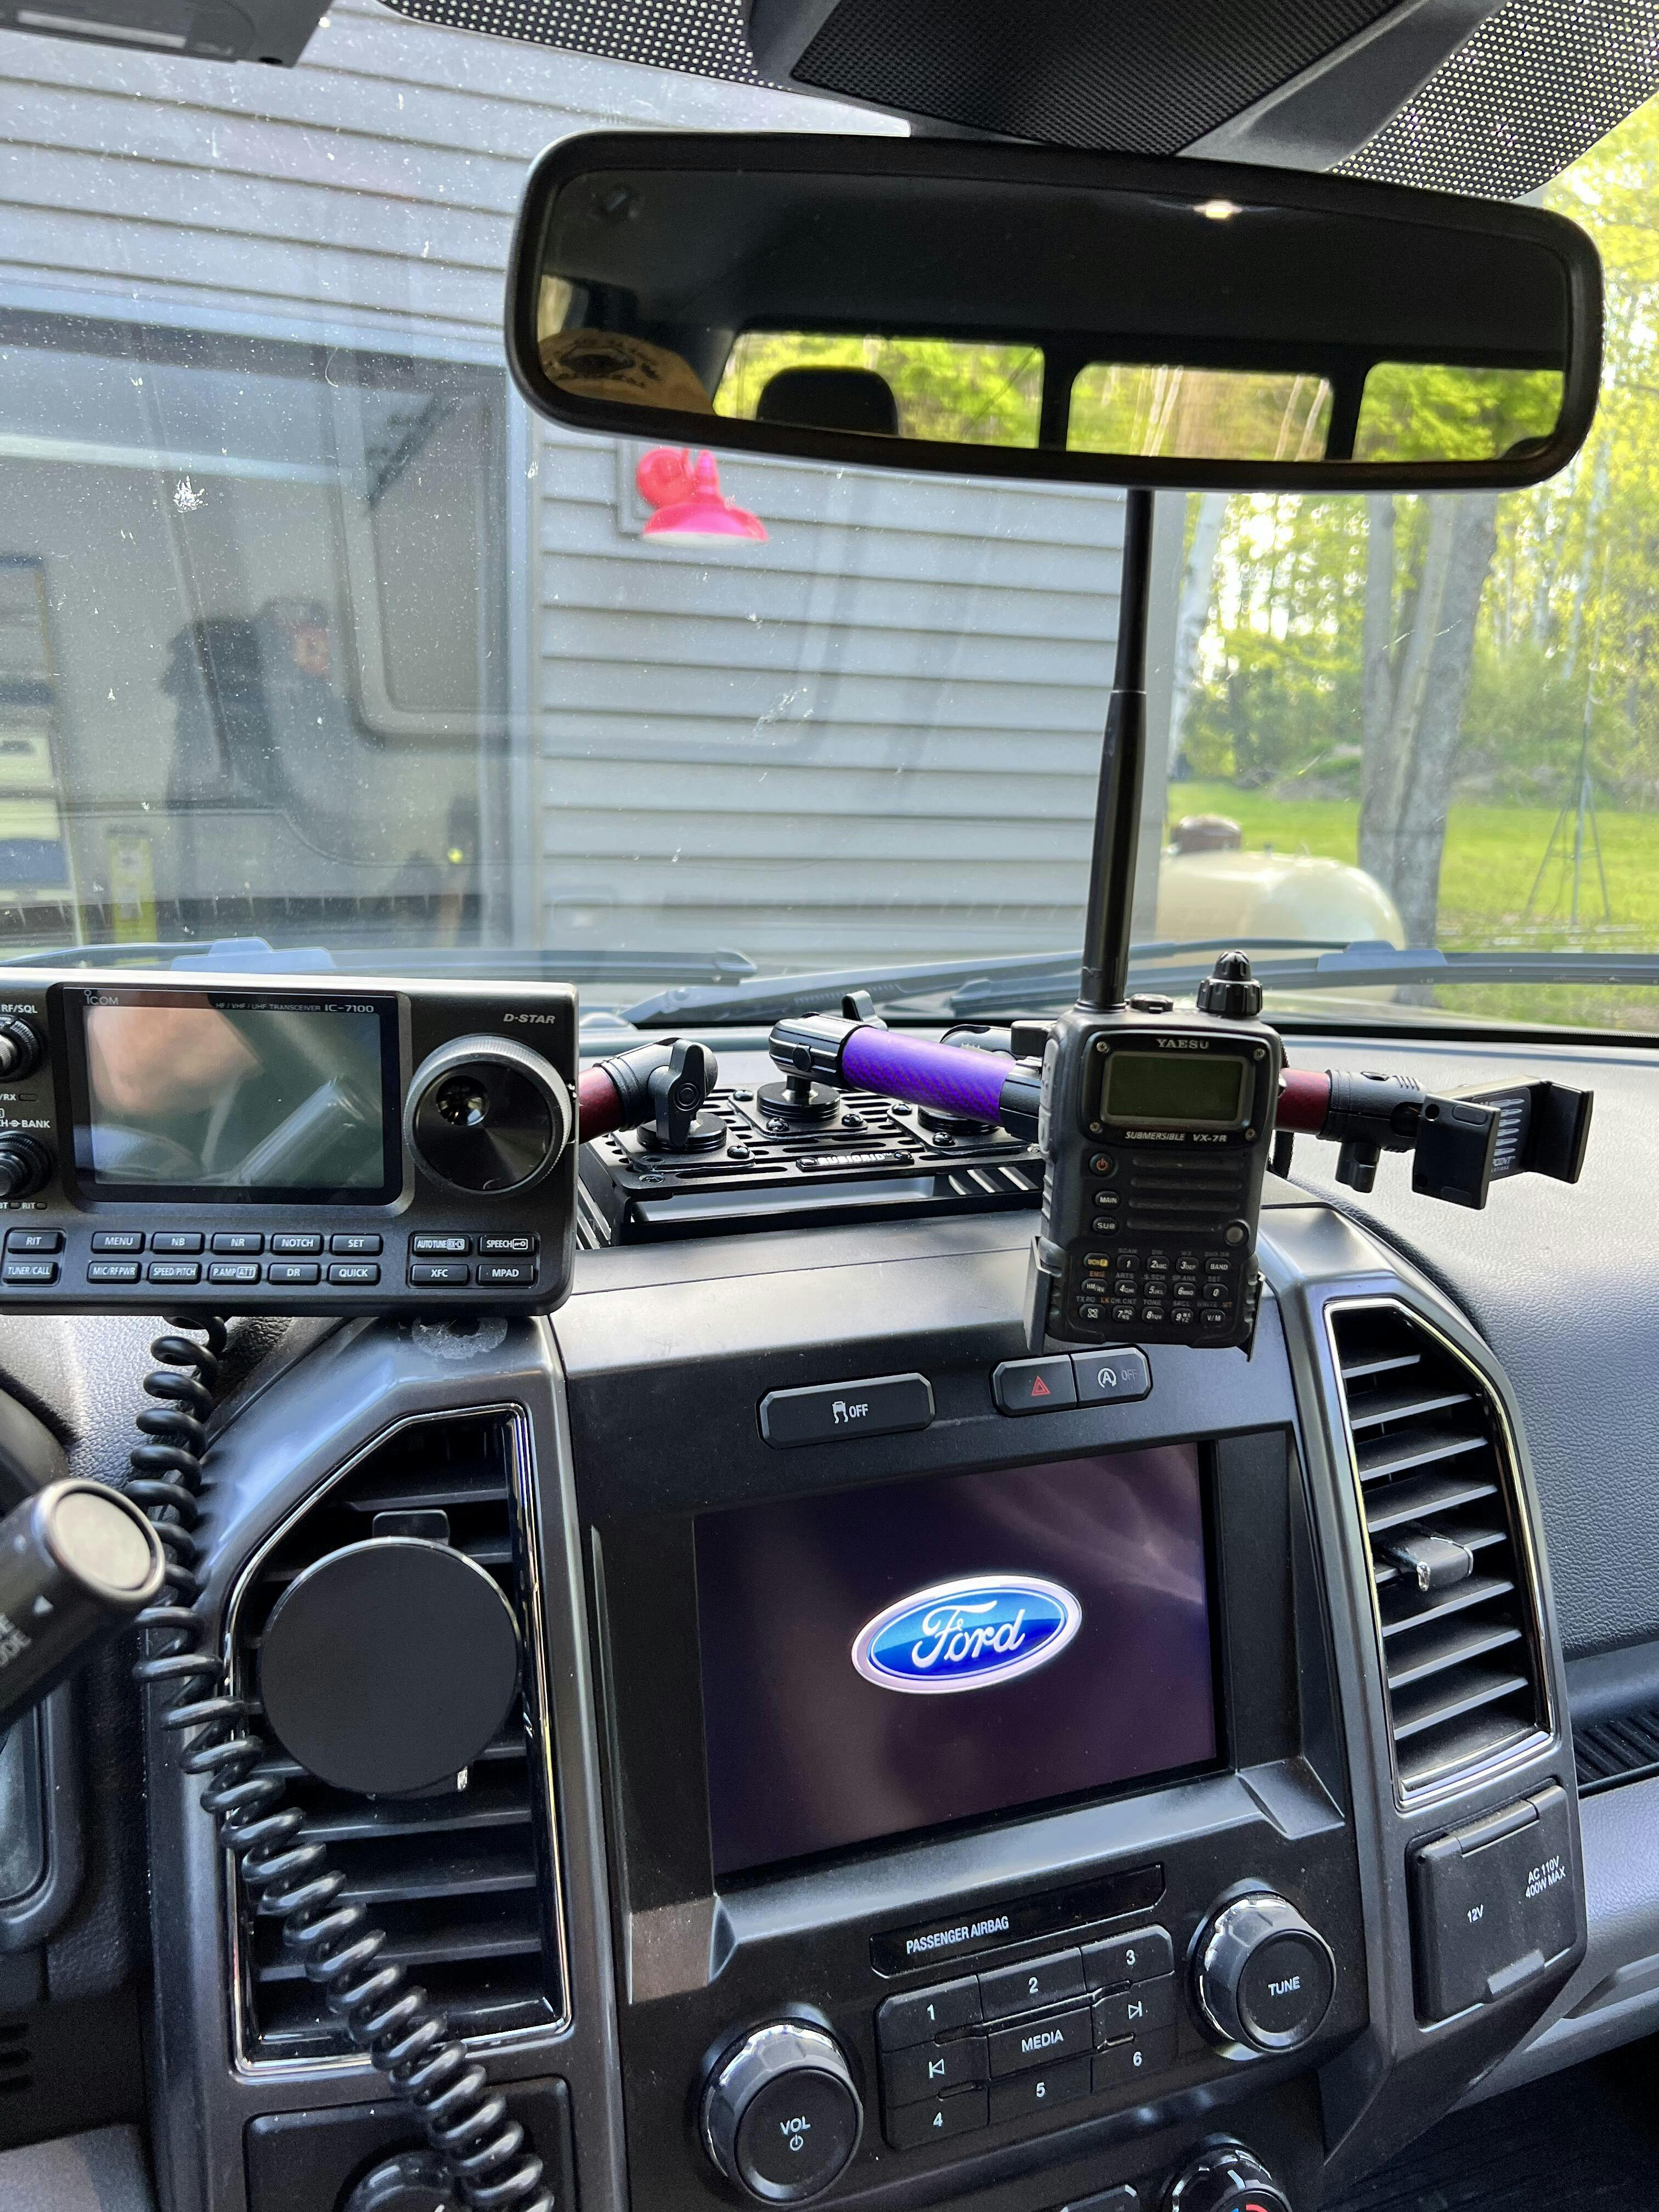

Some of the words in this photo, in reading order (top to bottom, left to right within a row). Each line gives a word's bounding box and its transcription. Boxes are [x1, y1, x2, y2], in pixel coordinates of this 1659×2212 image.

[1, 1004, 38, 1014] RF/SQL
[324, 1004, 374, 1013] IC-7100
[503, 1013, 556, 1024] D-STAR
[1156, 1039, 1210, 1049] YAESU
[21, 1119, 51, 1128] BANK
[1125, 1131, 1185, 1141] SUBMERSIBLE
[1193, 1134, 1227, 1142] VX-7R
[26, 1237, 42, 1245] RIT
[104, 1237, 133, 1245] MENU
[171, 1238, 185, 1246] NB
[230, 1238, 246, 1246] NR
[281, 1238, 314, 1247] NOTCH
[347, 1239, 365, 1248] SET
[486, 1239, 512, 1248] SPEECH
[286, 1268, 301, 1277] DR
[338, 1268, 369, 1278] QUICK
[431, 1269, 449, 1277] XFC
[492, 1269, 520, 1277] MPAD
[1212, 1288, 1220, 1297] 0
[1121, 1368, 1137, 1381] OFF
[849, 1403, 869, 1418] OFF
[911, 1600, 1026, 1668] Ford
[1528, 1867, 1541, 1884] AC
[1541, 1855, 1560, 1876] 110V
[1525, 1877, 1547, 1899] 400W
[1548, 1865, 1566, 1886] MAX
[1467, 1904, 1484, 1923] 12V
[906, 1926, 969, 1955] PASSENGER
[970, 1916, 1009, 1938] AIRBAG
[1126, 1949, 1136, 1965] 3
[1028, 1977, 1039, 1994] 2
[1268, 1976, 1301, 1996] TUNE
[927, 2004, 935, 2021] 1
[1022, 2029, 1064, 2052] MEDIA
[1133, 2051, 1142, 2067] 6
[1036, 2082, 1046, 2098] 5
[933, 2111, 943, 2128] 4
[780, 2115, 811, 2136] VOL
